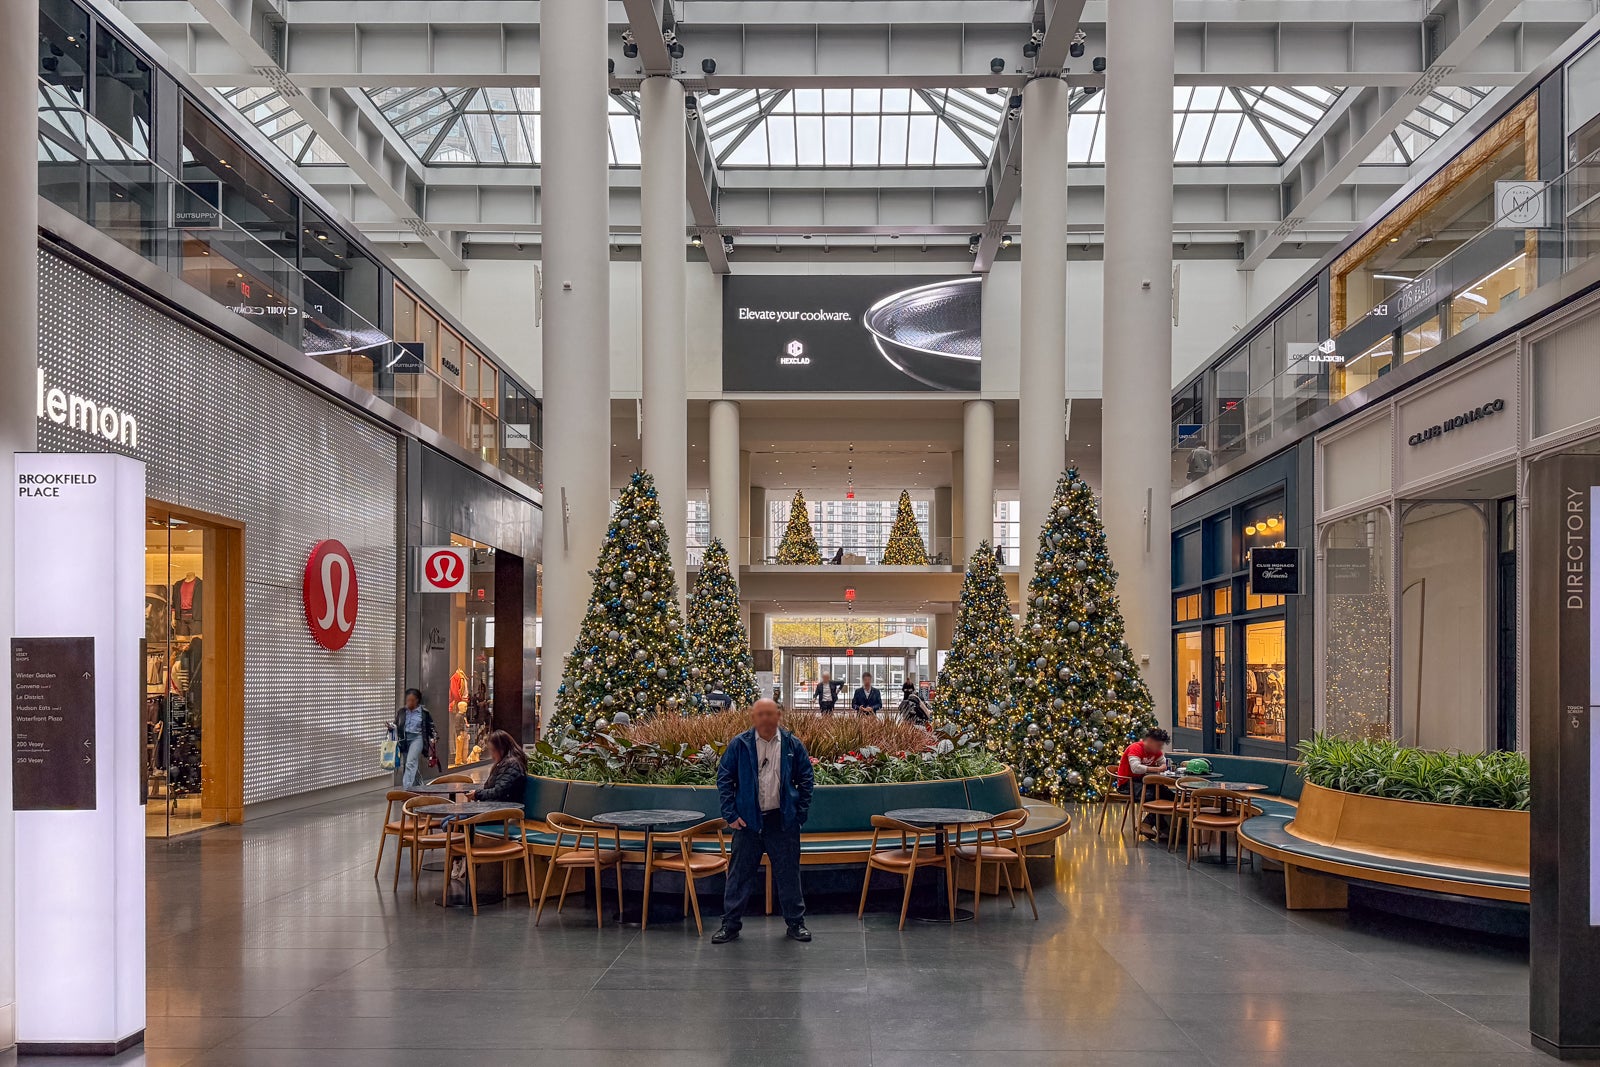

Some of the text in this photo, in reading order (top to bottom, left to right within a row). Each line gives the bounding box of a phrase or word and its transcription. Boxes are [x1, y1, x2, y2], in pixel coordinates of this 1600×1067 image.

[739, 308, 852, 323] Elevate your cookware.
[780, 357, 810, 365] HEXCLAD
[1408, 398, 1505, 446] CLUB MONACO
[18, 474, 97, 485] BROOKFIELD
[18, 487, 60, 497] PLACE
[1567, 486, 1584, 610] DIRECTORY
